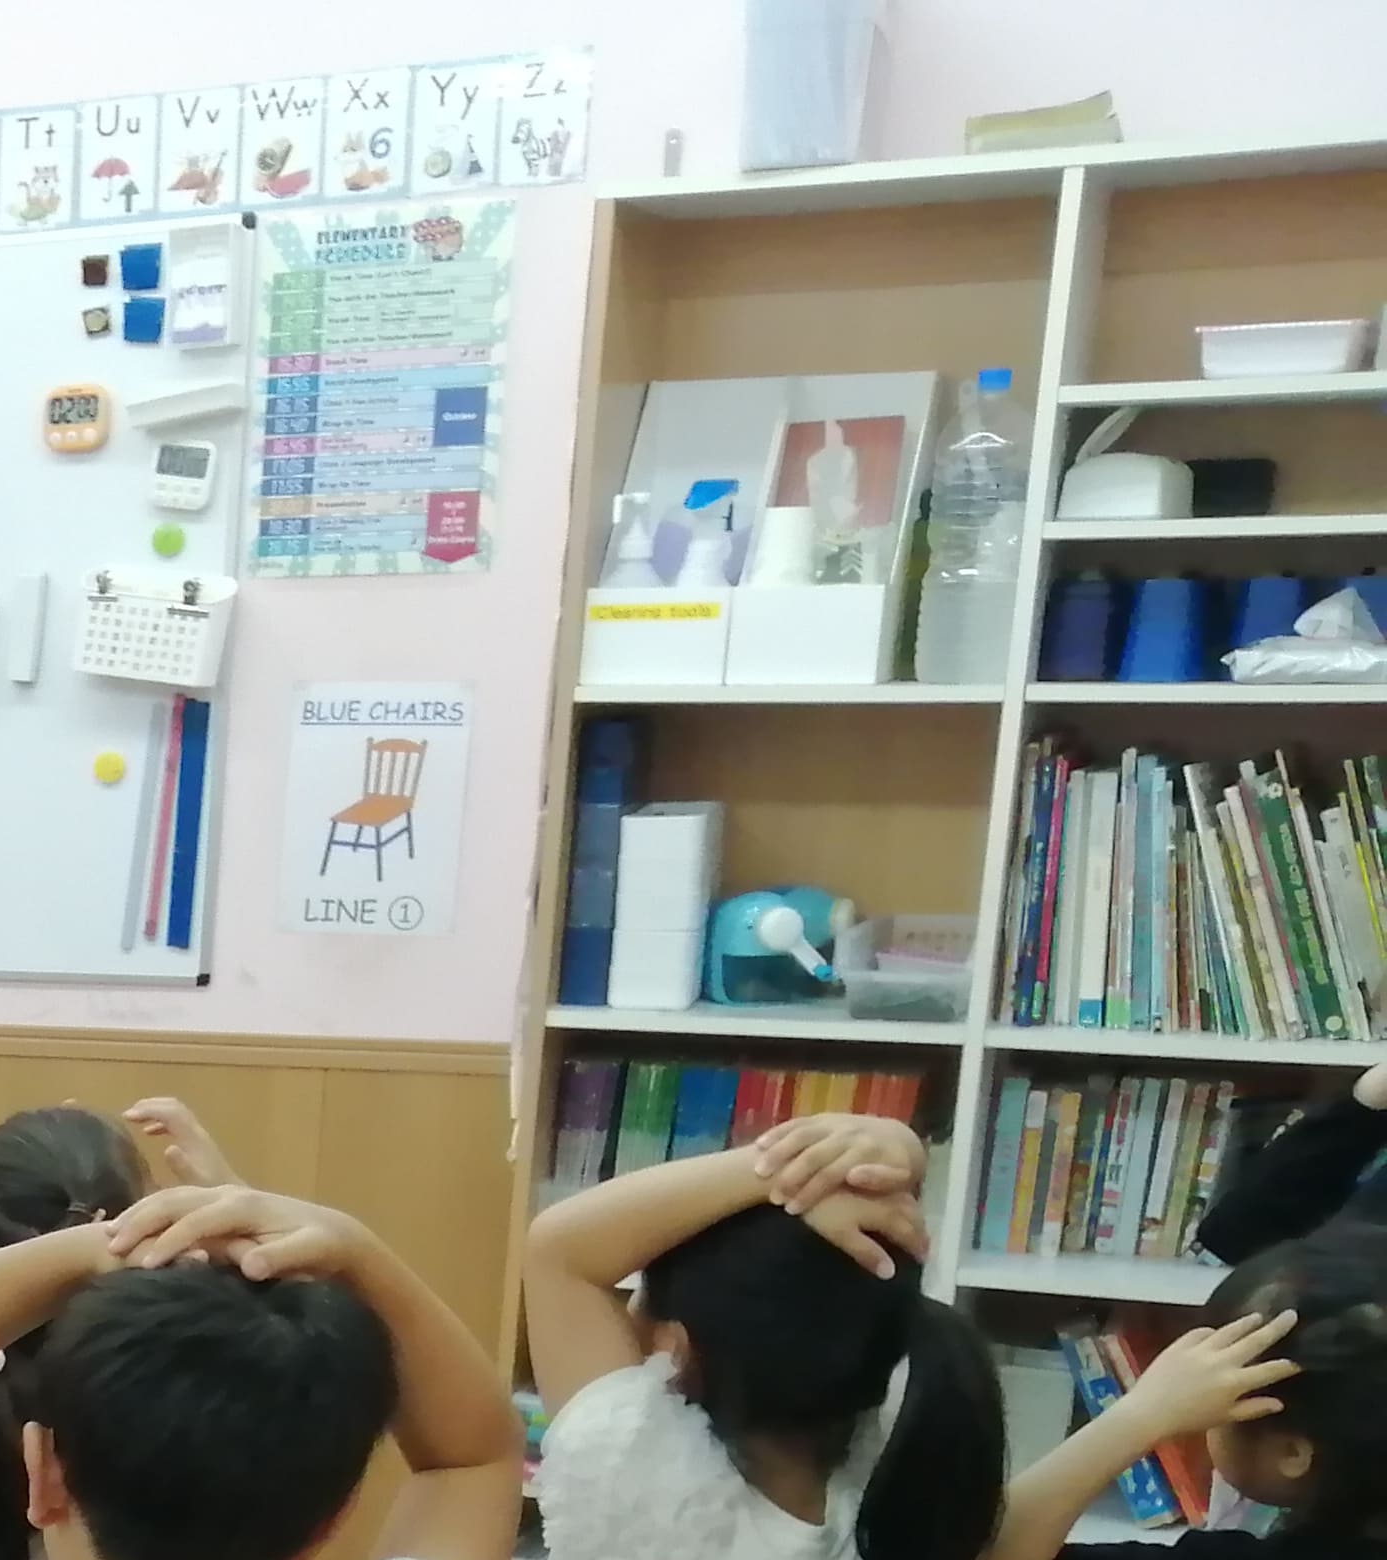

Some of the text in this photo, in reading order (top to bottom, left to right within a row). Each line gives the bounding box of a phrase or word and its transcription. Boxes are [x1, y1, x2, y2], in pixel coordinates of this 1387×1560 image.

[17, 117, 55, 149] Tt
[97, 104, 140, 136] Uu
[178, 96, 219, 128] Vv
[252, 86, 317, 120] Ww
[344, 78, 389, 112] Xx
[431, 73, 478, 120] Yy
[523, 62, 566, 97] Zz
[302, 700, 464, 722] BLUE CHAIRS
[304, 898, 377, 924] LINE
